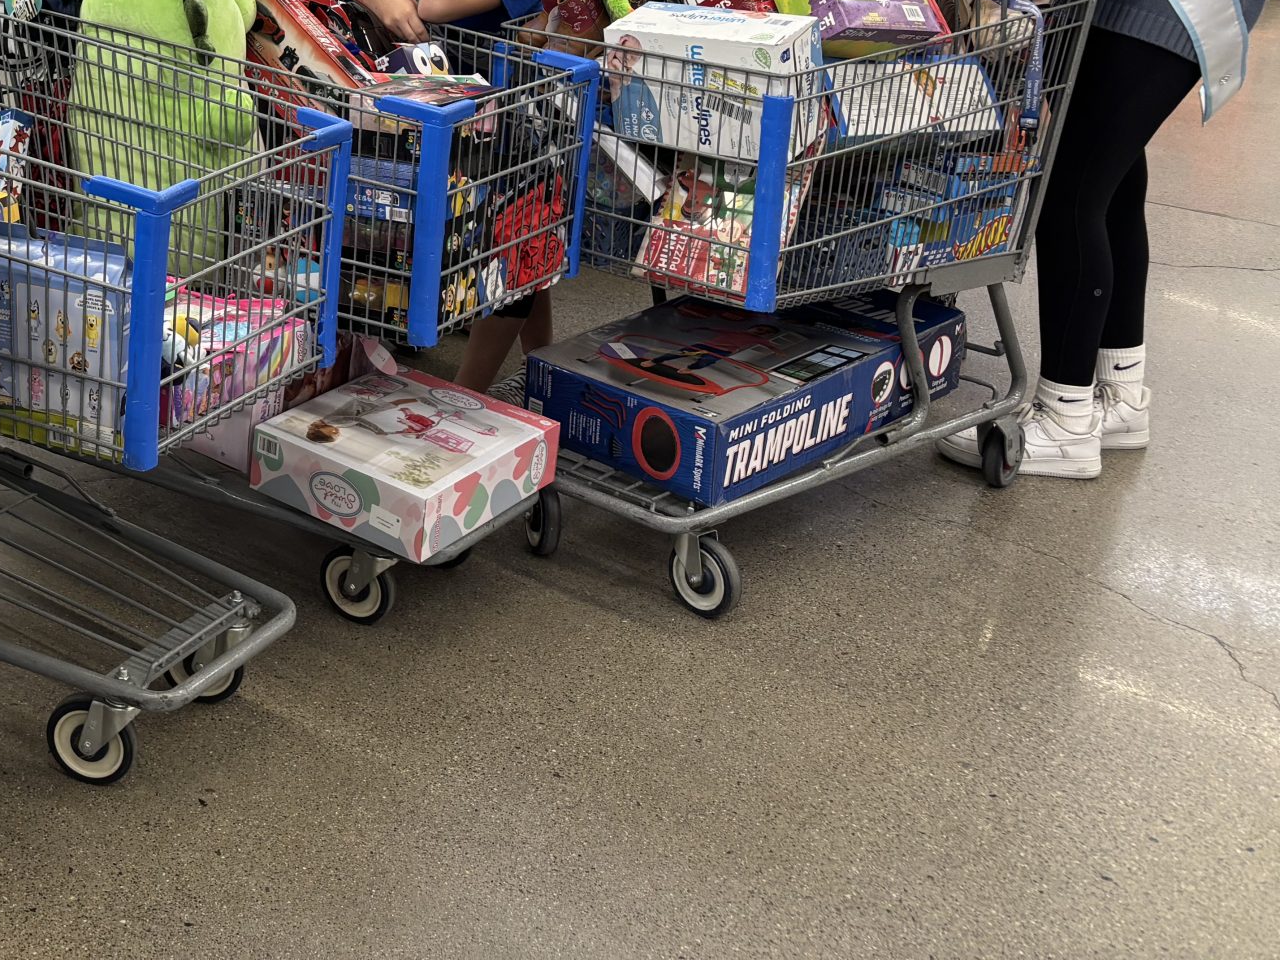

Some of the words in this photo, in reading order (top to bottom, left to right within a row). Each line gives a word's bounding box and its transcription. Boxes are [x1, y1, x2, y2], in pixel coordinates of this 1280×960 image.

[669, 231, 690, 272] PUZZLE
[723, 392, 853, 488] TRAMPOLINE
[728, 421, 758, 443] MINI
[760, 394, 812, 429] FOLDING
[693, 465, 702, 490] Sports
